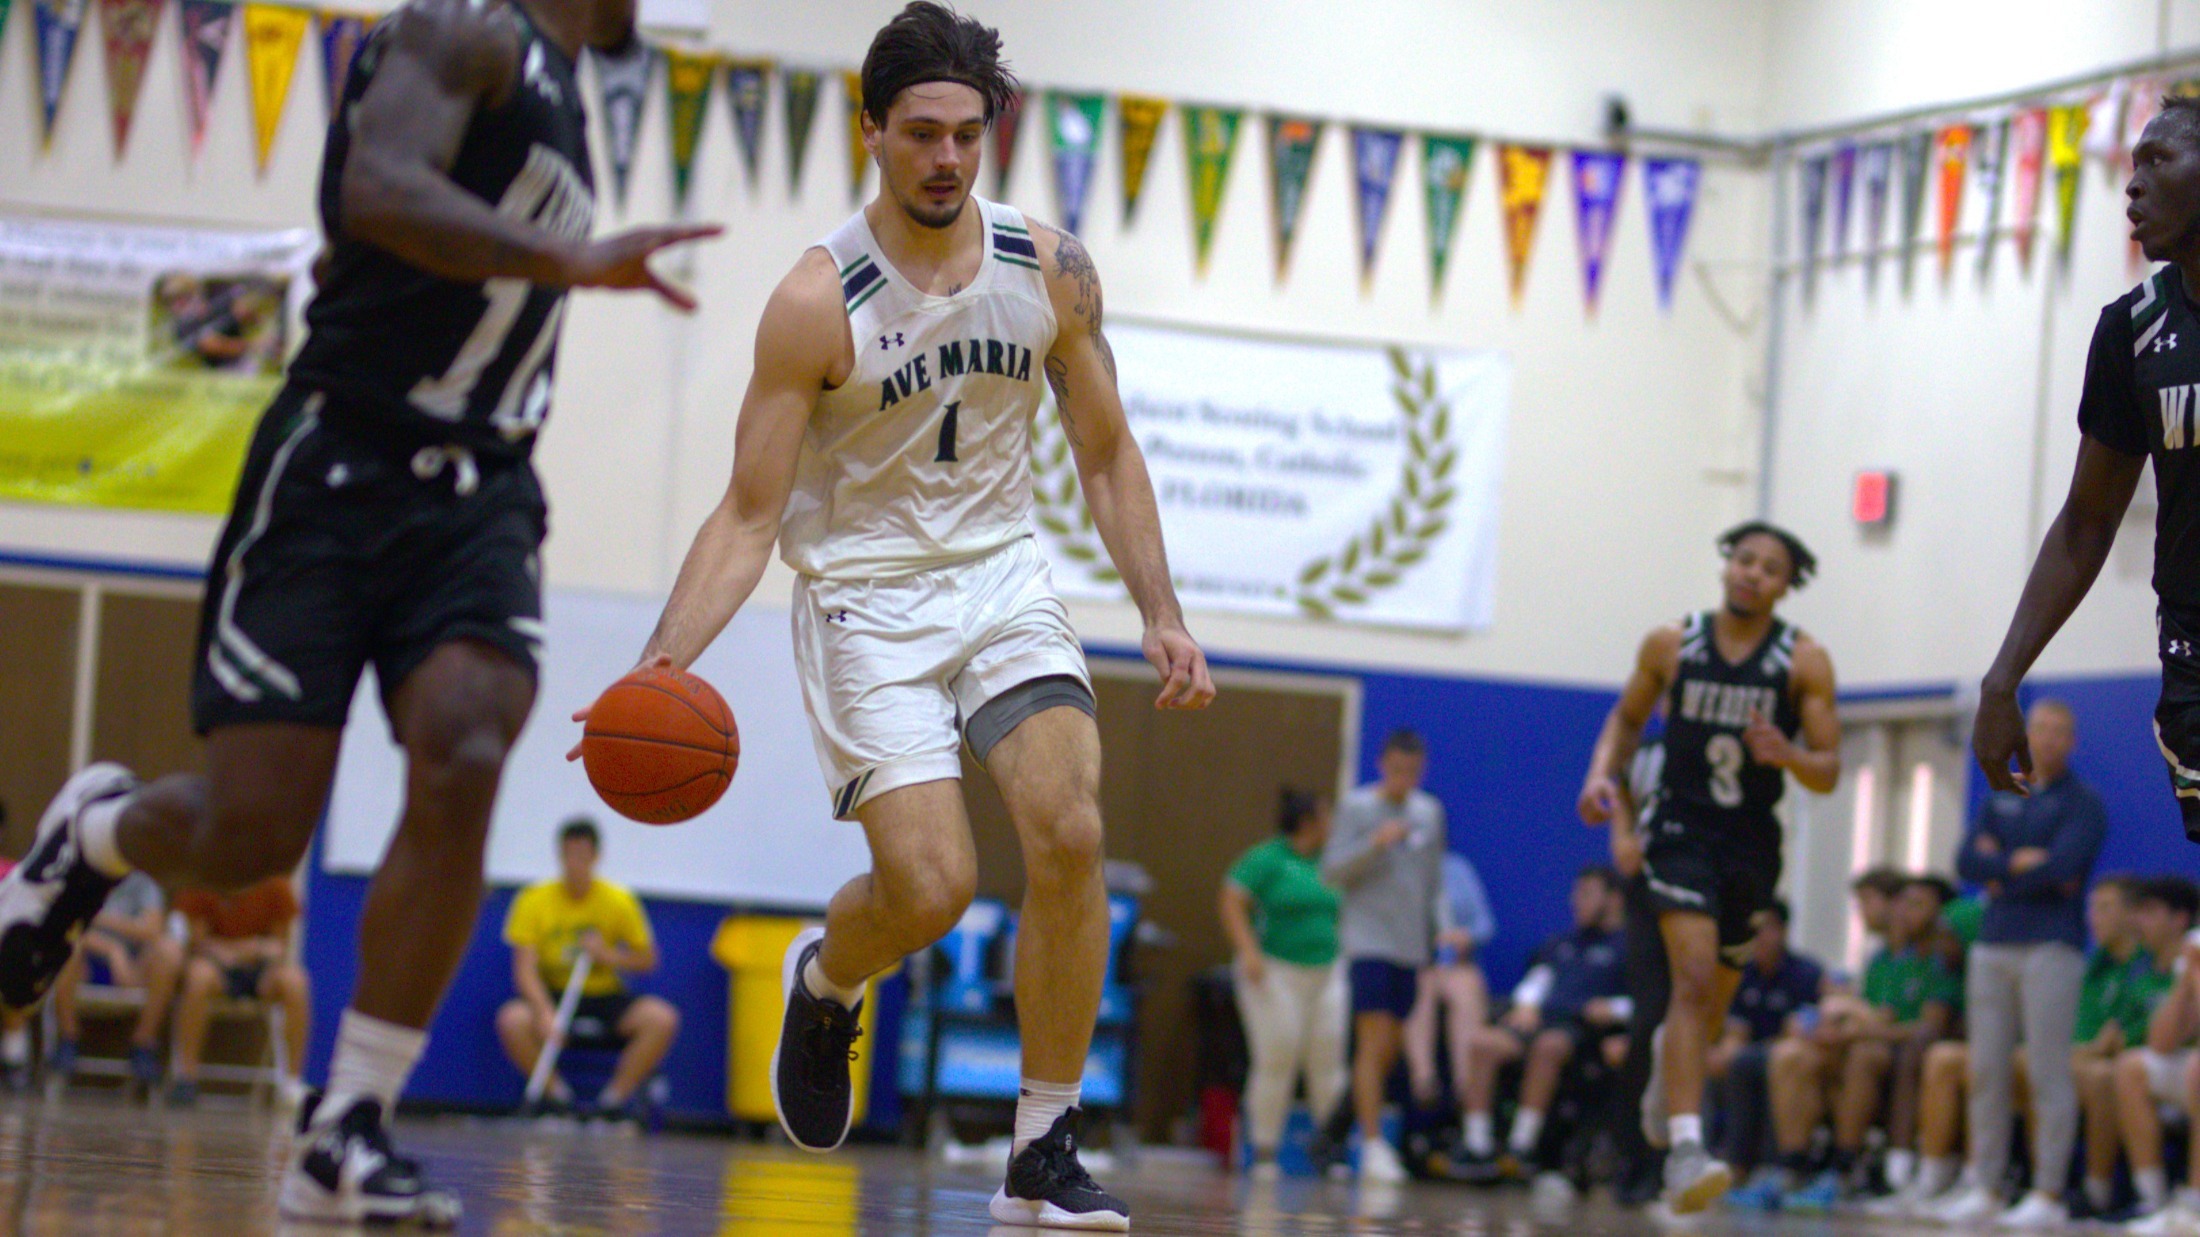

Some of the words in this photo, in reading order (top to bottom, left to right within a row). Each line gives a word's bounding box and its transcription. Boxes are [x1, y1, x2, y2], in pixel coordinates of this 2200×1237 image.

[879, 353, 932, 411] AVE
[938, 338, 1032, 382] MARIA
[934, 400, 962, 463] 1
[2158, 383, 2200, 450] W
[1705, 734, 1743, 807] 3
